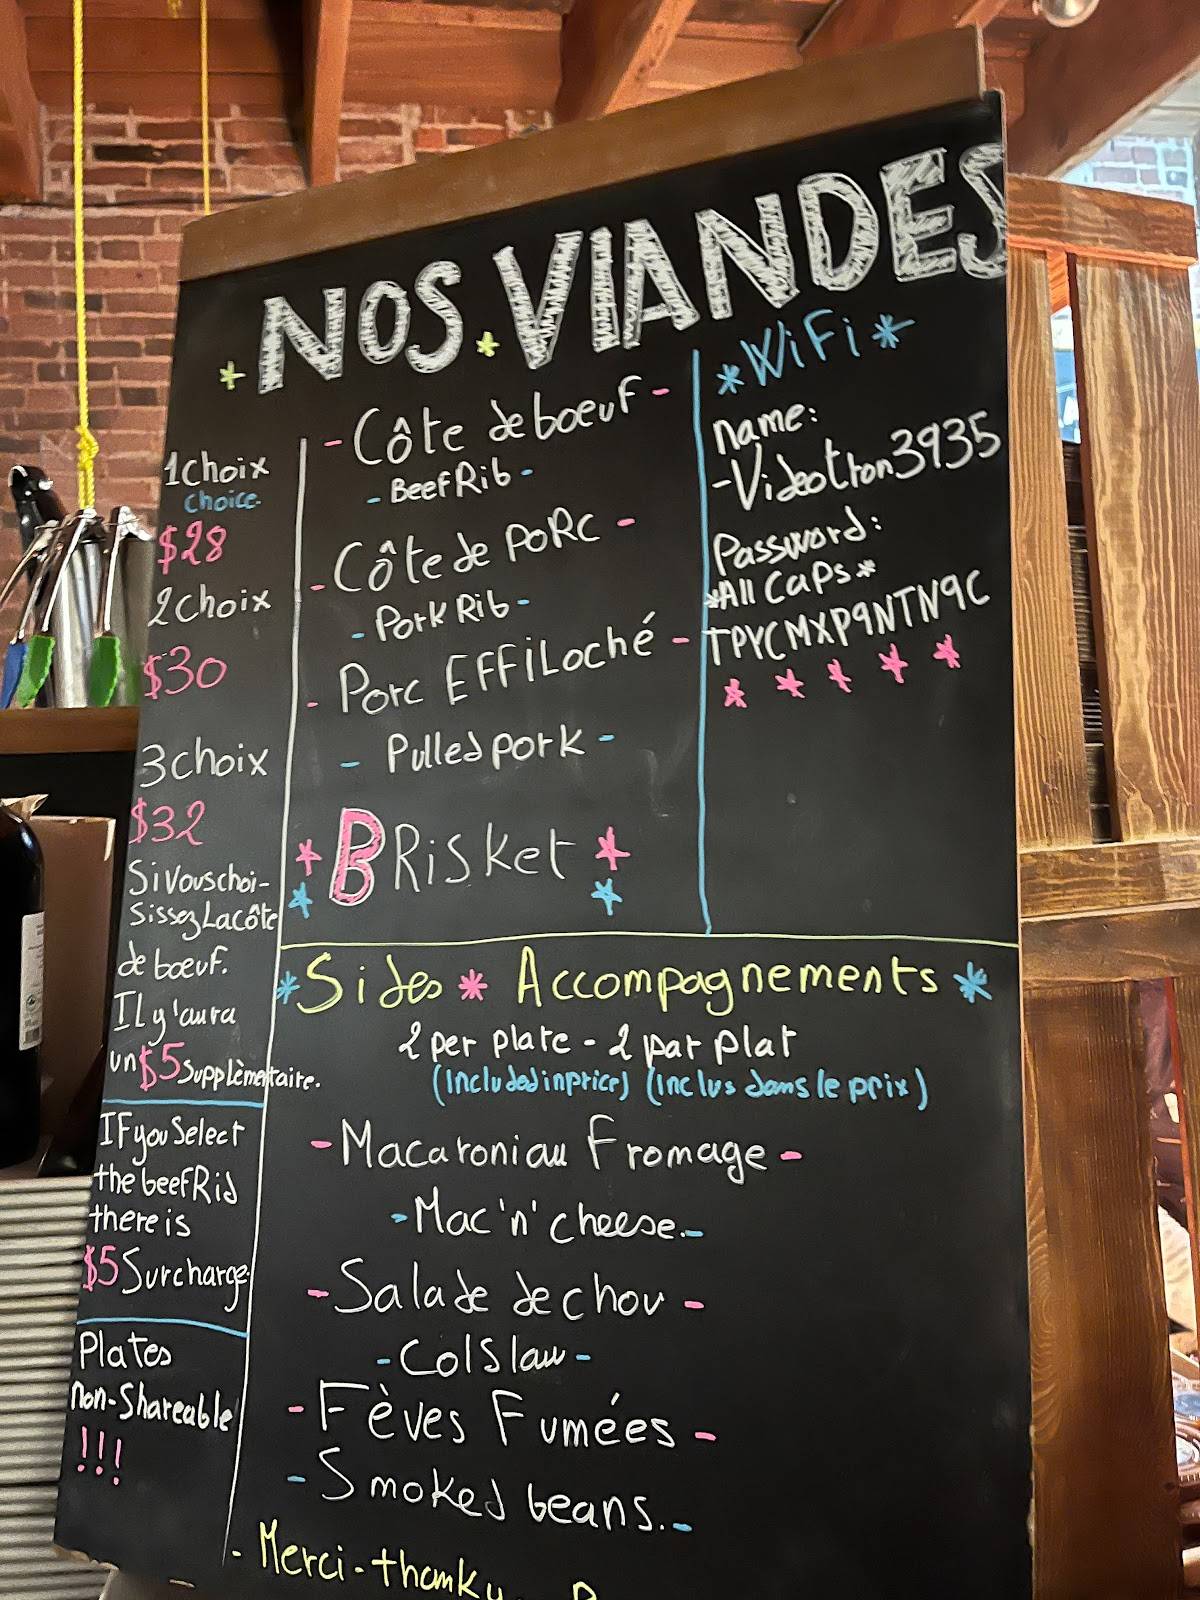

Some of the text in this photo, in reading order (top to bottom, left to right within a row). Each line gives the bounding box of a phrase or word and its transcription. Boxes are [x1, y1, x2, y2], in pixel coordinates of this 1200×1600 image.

[258, 142, 1006, 393] NOS VIANDES
[741, 309, 861, 387] WiFi
[353, 406, 465, 466] Côte
[157, 520, 228, 576] $28
[334, 533, 443, 593] Côte
[453, 532, 490, 574] de
[713, 505, 882, 576] Password:
[143, 645, 228, 700] $30
[339, 662, 424, 716] Porc
[387, 731, 482, 774] Pulled
[128, 797, 207, 847] $32
[117, 940, 147, 977] de
[297, 944, 940, 1017] Sides Accompagnements
[110, 1050, 138, 1073] un
[139, 1042, 186, 1093] $5
[398, 1020, 422, 1061] 2
[430, 1031, 478, 1063] per
[493, 1023, 573, 1059] plate
[608, 1022, 633, 1061] 2
[643, 1033, 702, 1069] par
[714, 1023, 798, 1066] plat
[93, 1163, 137, 1195] the
[88, 1204, 192, 1238] there is
[82, 1244, 119, 1293] $5
[333, 1256, 490, 1315] Salade
[513, 1270, 551, 1317] de
[78, 1331, 173, 1371] Plates
[319, 1379, 467, 1445] Fèves
[318, 1446, 506, 1522] Smoked
[259, 1518, 346, 1582] Merci
